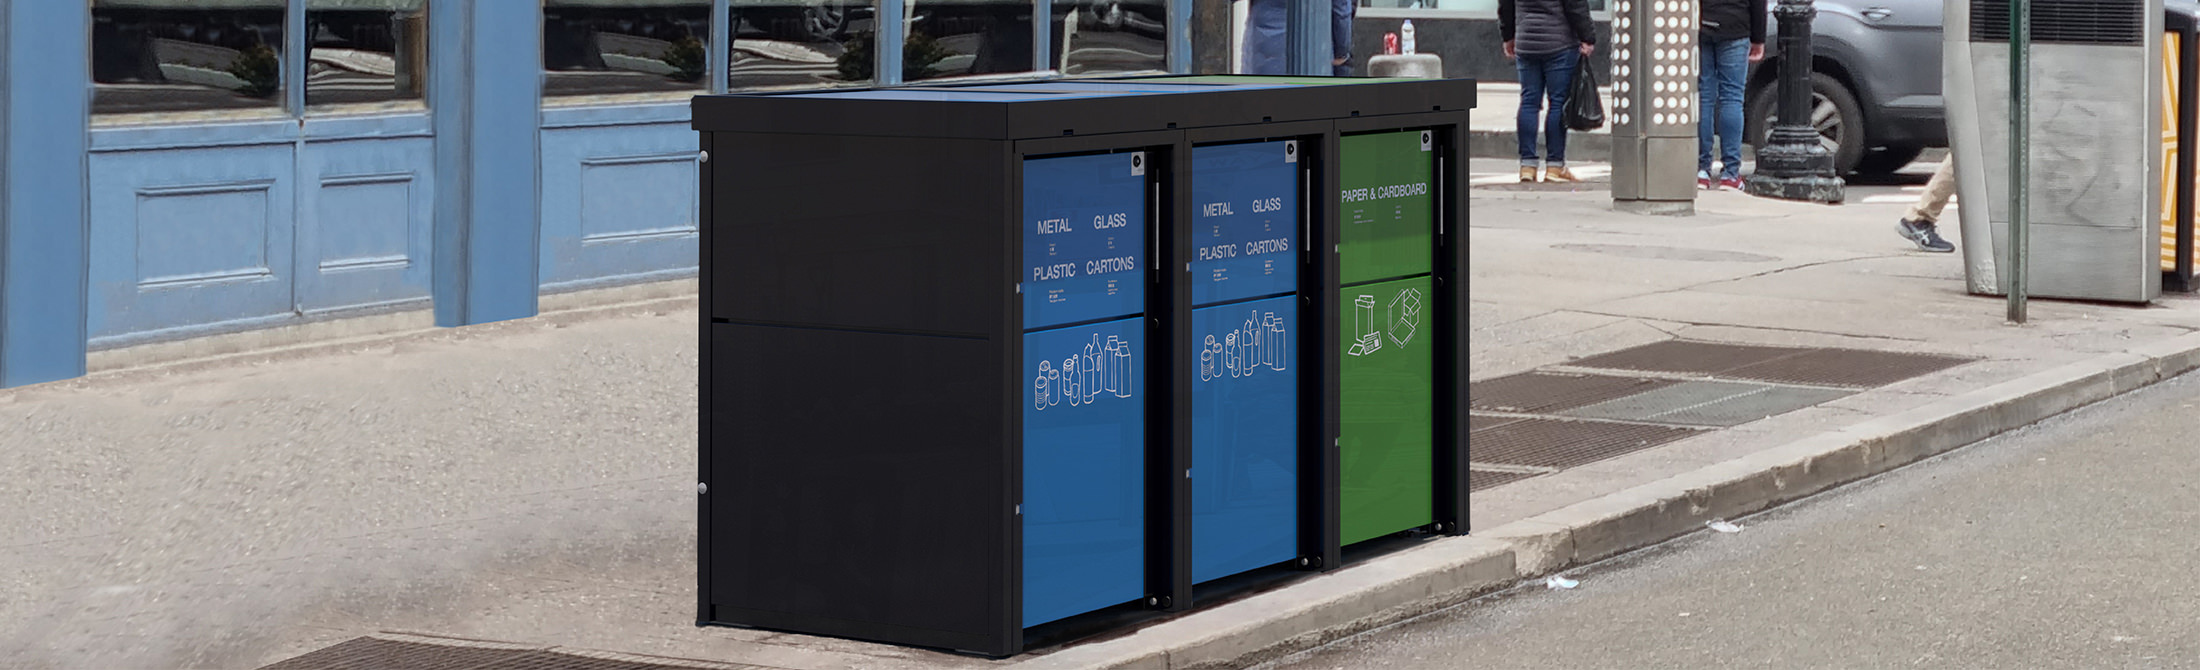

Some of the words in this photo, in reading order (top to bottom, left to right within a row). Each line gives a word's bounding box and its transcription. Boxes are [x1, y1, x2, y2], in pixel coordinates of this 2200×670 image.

[1341, 188, 1368, 203] PAPER
[1369, 187, 1376, 200] &
[1377, 182, 1427, 199] CARDBOARD
[1203, 202, 1234, 218] METAL
[1252, 197, 1281, 213] GLASS
[1037, 218, 1072, 235] METAL
[1093, 212, 1127, 230] GLASS
[1199, 243, 1237, 261] PLASTIC
[1245, 237, 1288, 256] CARTONS
[1033, 262, 1076, 282] PLASTIC
[1086, 255, 1135, 275] CARTONS
